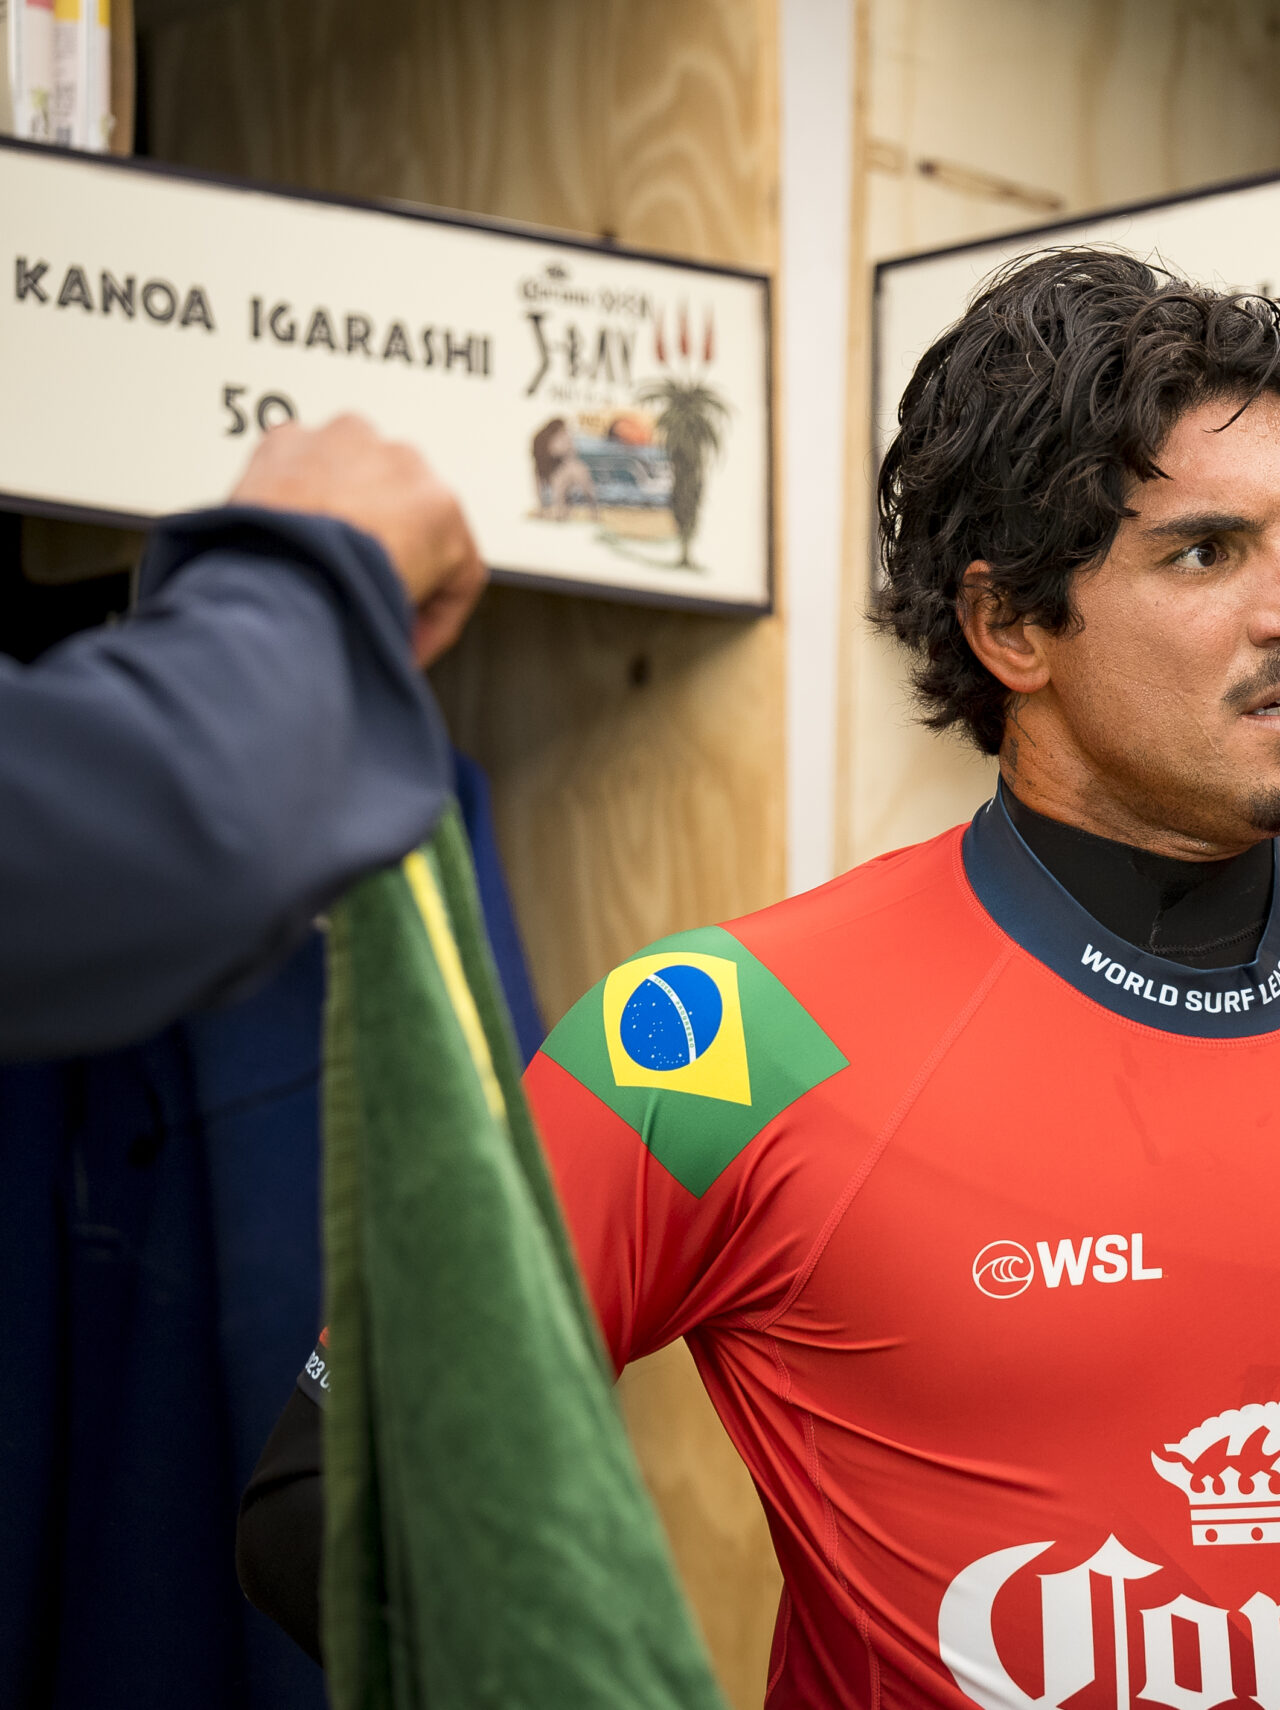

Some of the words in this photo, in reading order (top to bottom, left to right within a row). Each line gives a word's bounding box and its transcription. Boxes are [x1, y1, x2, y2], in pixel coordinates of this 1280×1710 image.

[14, 255, 215, 333] KANOA
[249, 294, 494, 378] IGARASHI
[221, 382, 297, 437] 50
[1080, 943, 1178, 1007] WORLD
[1184, 987, 1255, 1014] SURF
[1036, 1233, 1163, 1288] WSL
